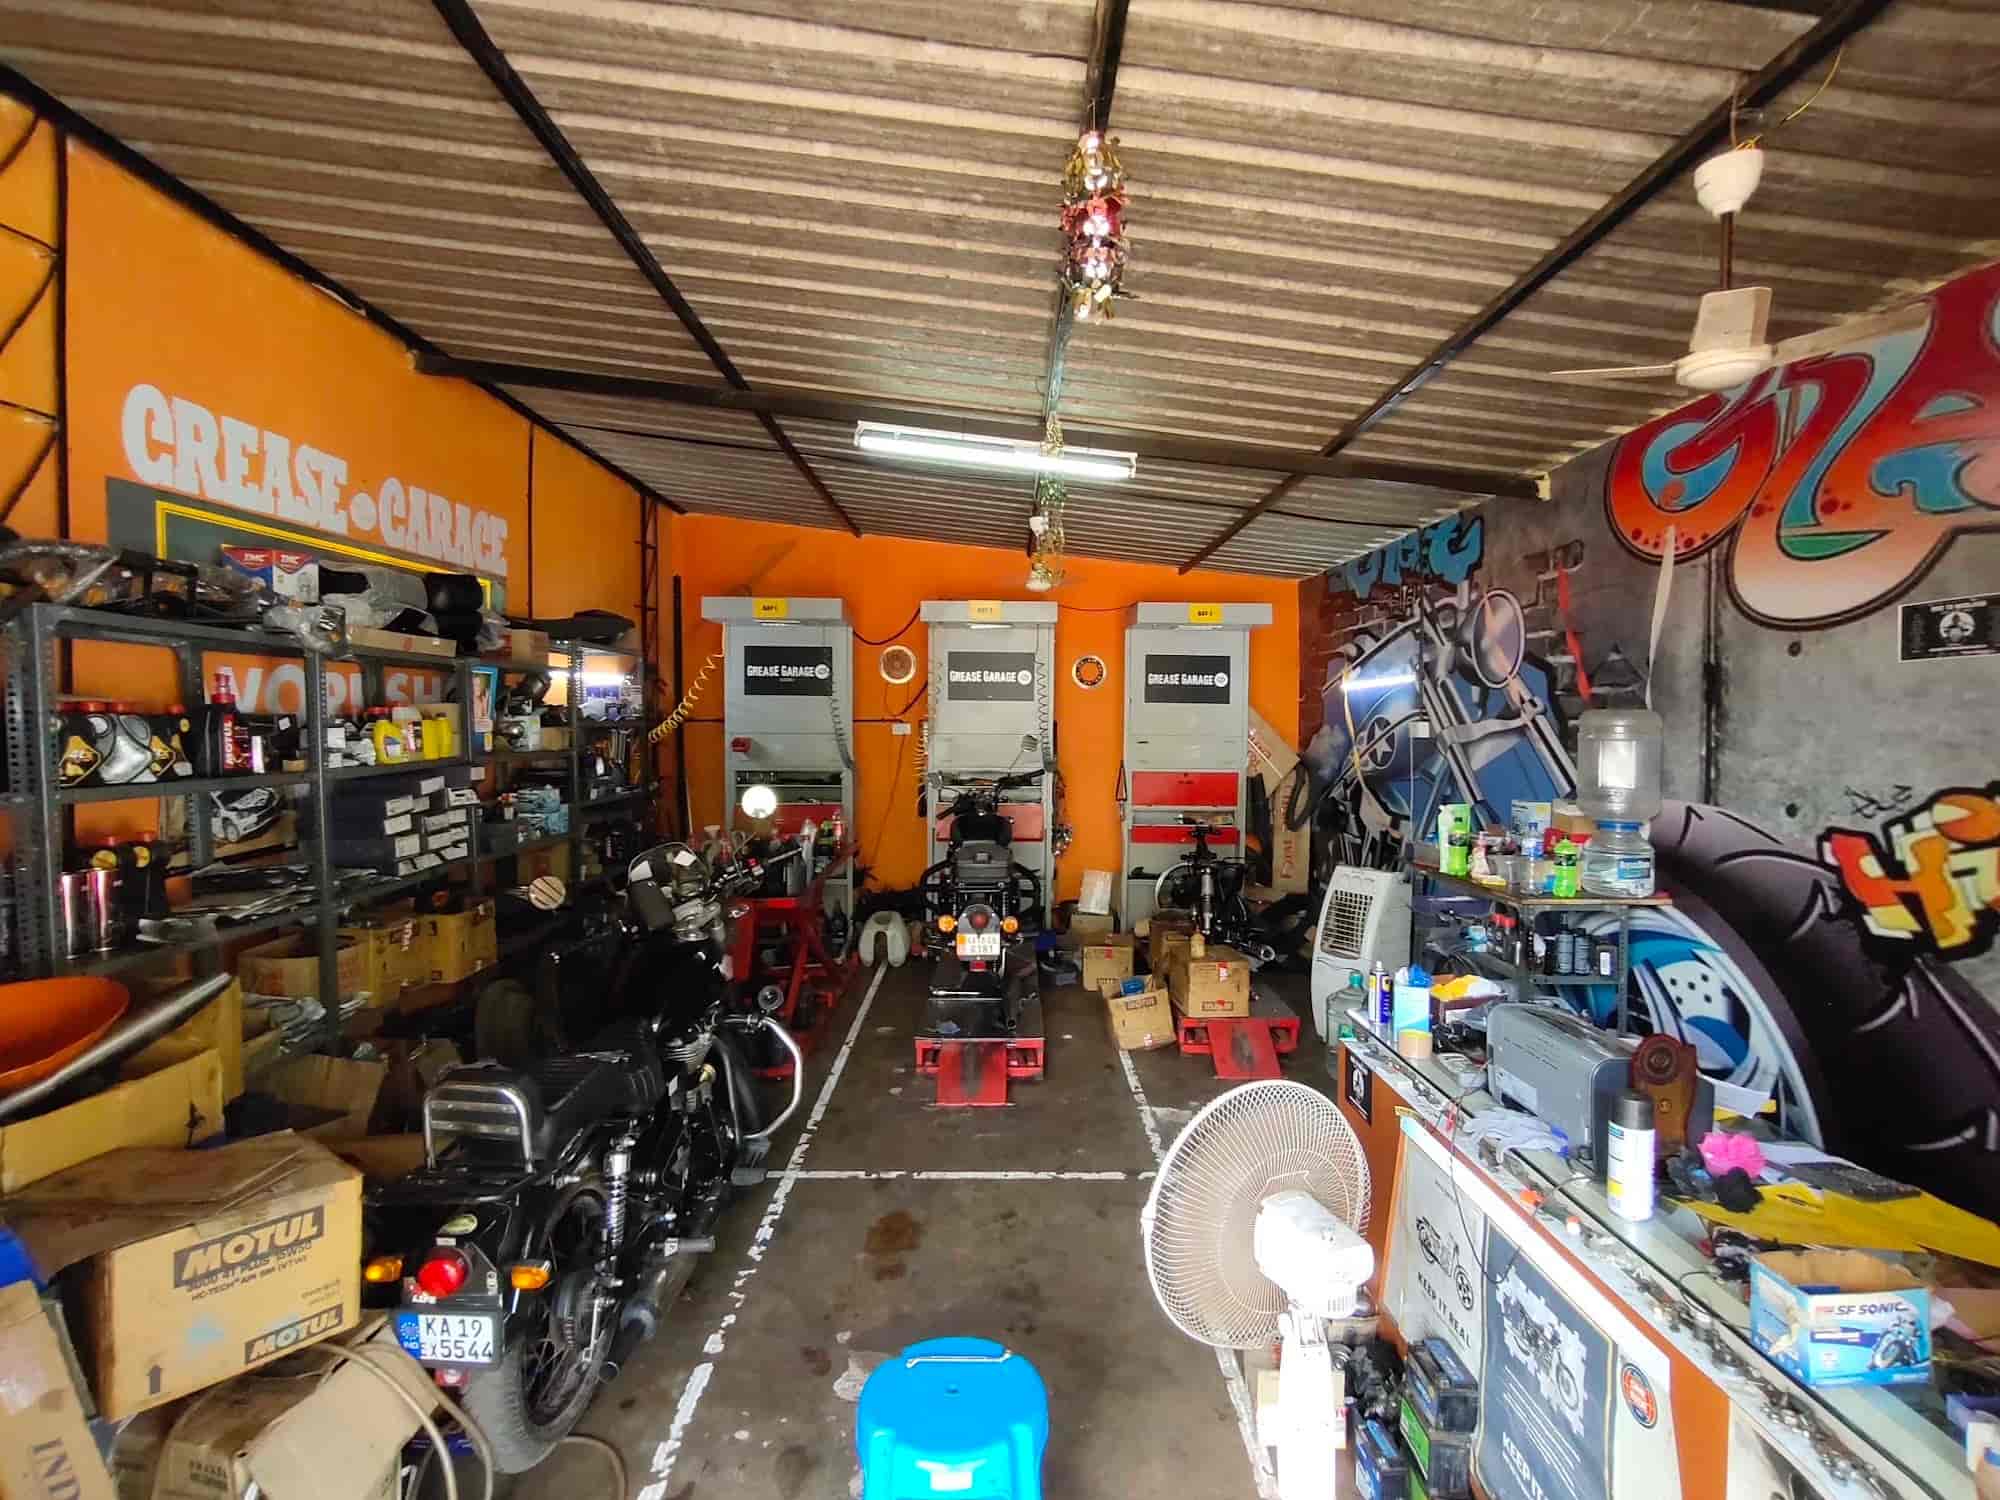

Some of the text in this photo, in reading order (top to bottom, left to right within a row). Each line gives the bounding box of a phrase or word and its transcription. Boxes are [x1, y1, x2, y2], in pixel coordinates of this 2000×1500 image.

[747, 665, 815, 678] GREASE GARAGE
[949, 670, 1017, 683] GREASE GARAGE
[1147, 673, 1214, 686] GREASE GARAGE
[181, 1212, 319, 1282] MOTUL
[1417, 1271, 1437, 1300] KEEP
[1448, 1312, 1472, 1350] REAL
[1834, 1305, 1857, 1316] SF
[1858, 1301, 1910, 1315] SONIC
[250, 1308, 340, 1360] MOTUL
[425, 1317, 483, 1338] KA 19
